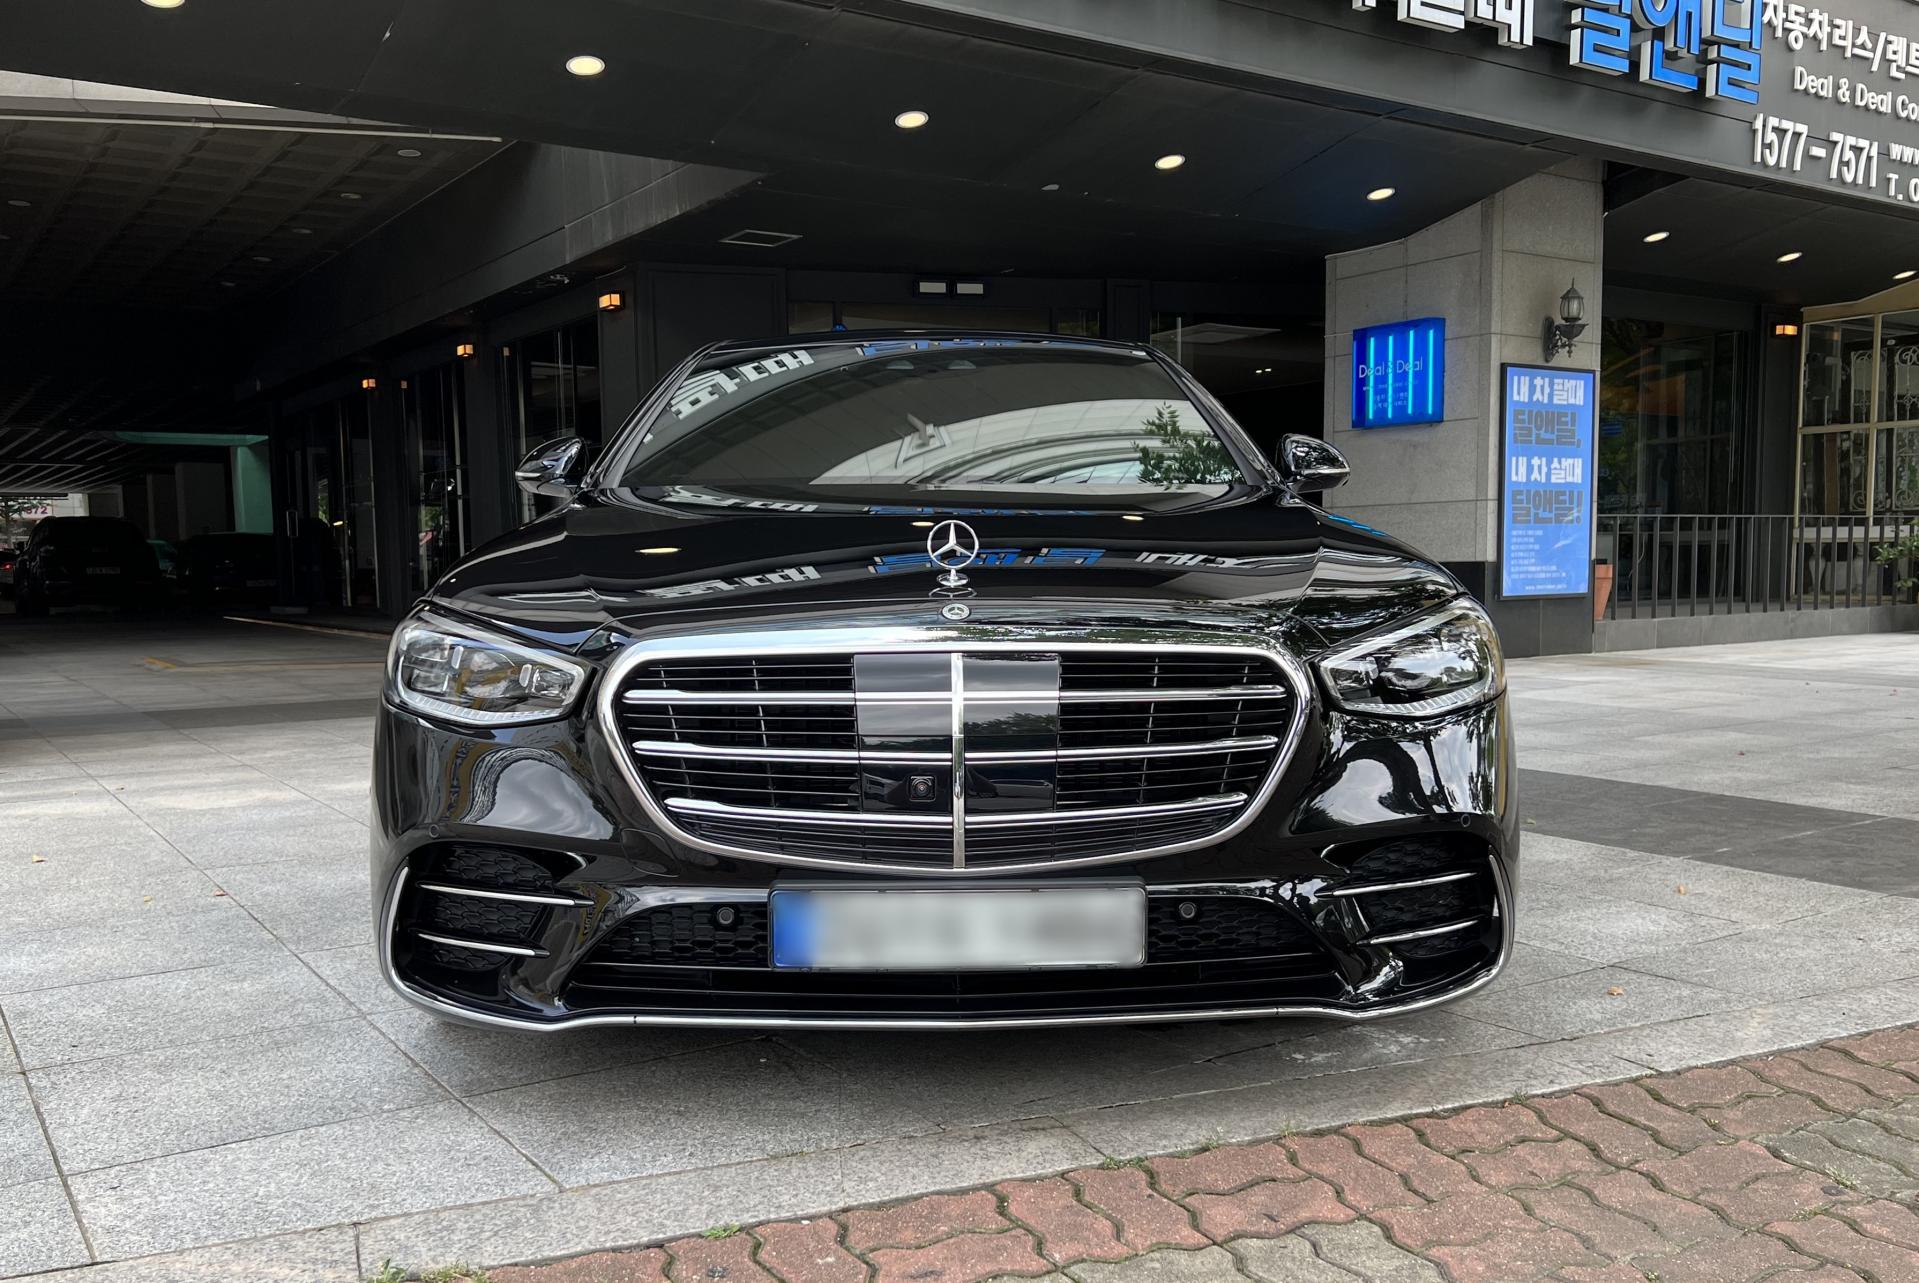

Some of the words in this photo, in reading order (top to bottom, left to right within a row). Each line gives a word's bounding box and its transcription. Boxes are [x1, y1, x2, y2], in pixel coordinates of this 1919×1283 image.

[1762, 0, 1919, 80] 자동차리스/렌트
[1794, 66, 1833, 98] Deal
[1837, 77, 1850, 103] &
[1855, 83, 1892, 113] Deal
[1896, 94, 1919, 121] Co
[1752, 113, 1878, 188] 1577-7571
[1396, 356, 1423, 374] Deal
[1513, 375, 1530, 403] 내
[1532, 376, 1550, 404] 차
[1511, 456, 1527, 482] 내
[1531, 456, 1548, 483] 차
